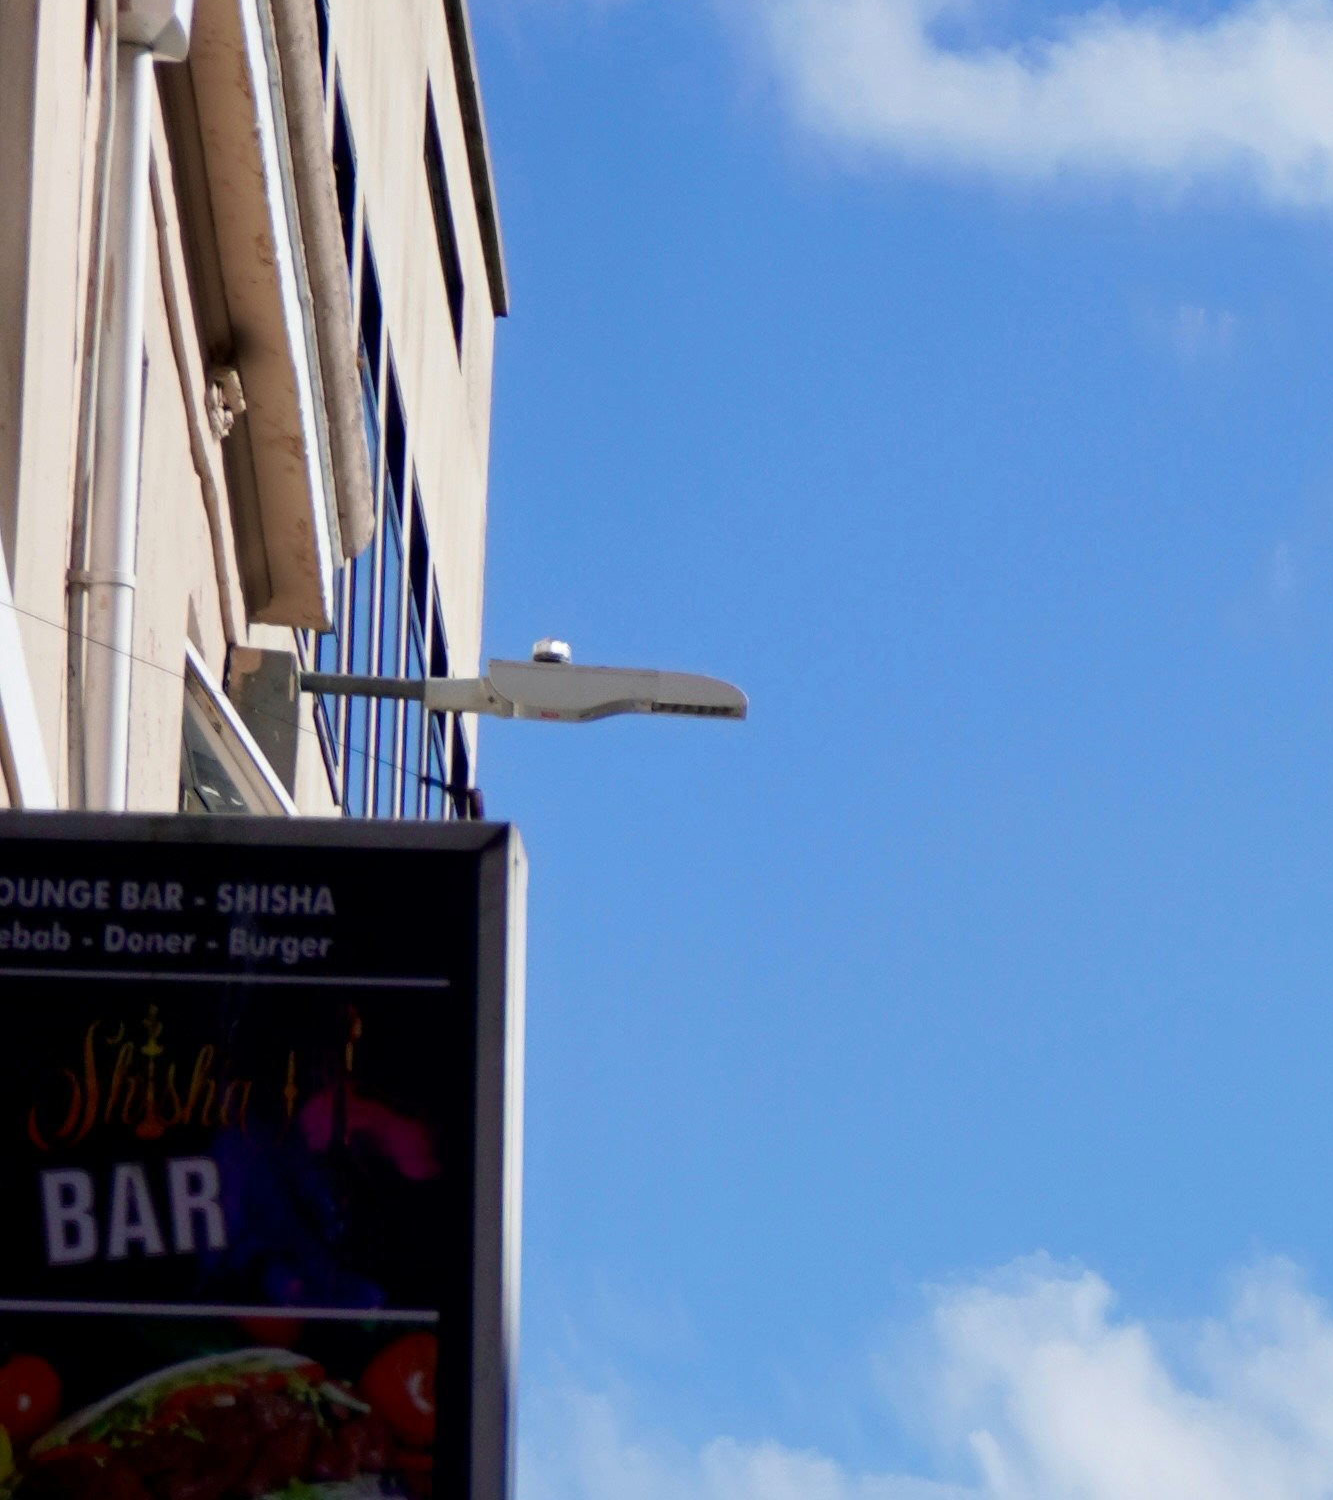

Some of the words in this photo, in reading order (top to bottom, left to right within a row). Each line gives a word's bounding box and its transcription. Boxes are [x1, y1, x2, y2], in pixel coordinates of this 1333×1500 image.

[119, 879, 185, 913] BAR
[214, 882, 337, 917] SHISHA
[103, 922, 198, 955] Doner
[228, 926, 335, 966] Burger
[26, 1002, 255, 1153] Shisha
[38, 1153, 231, 1269] BAR
